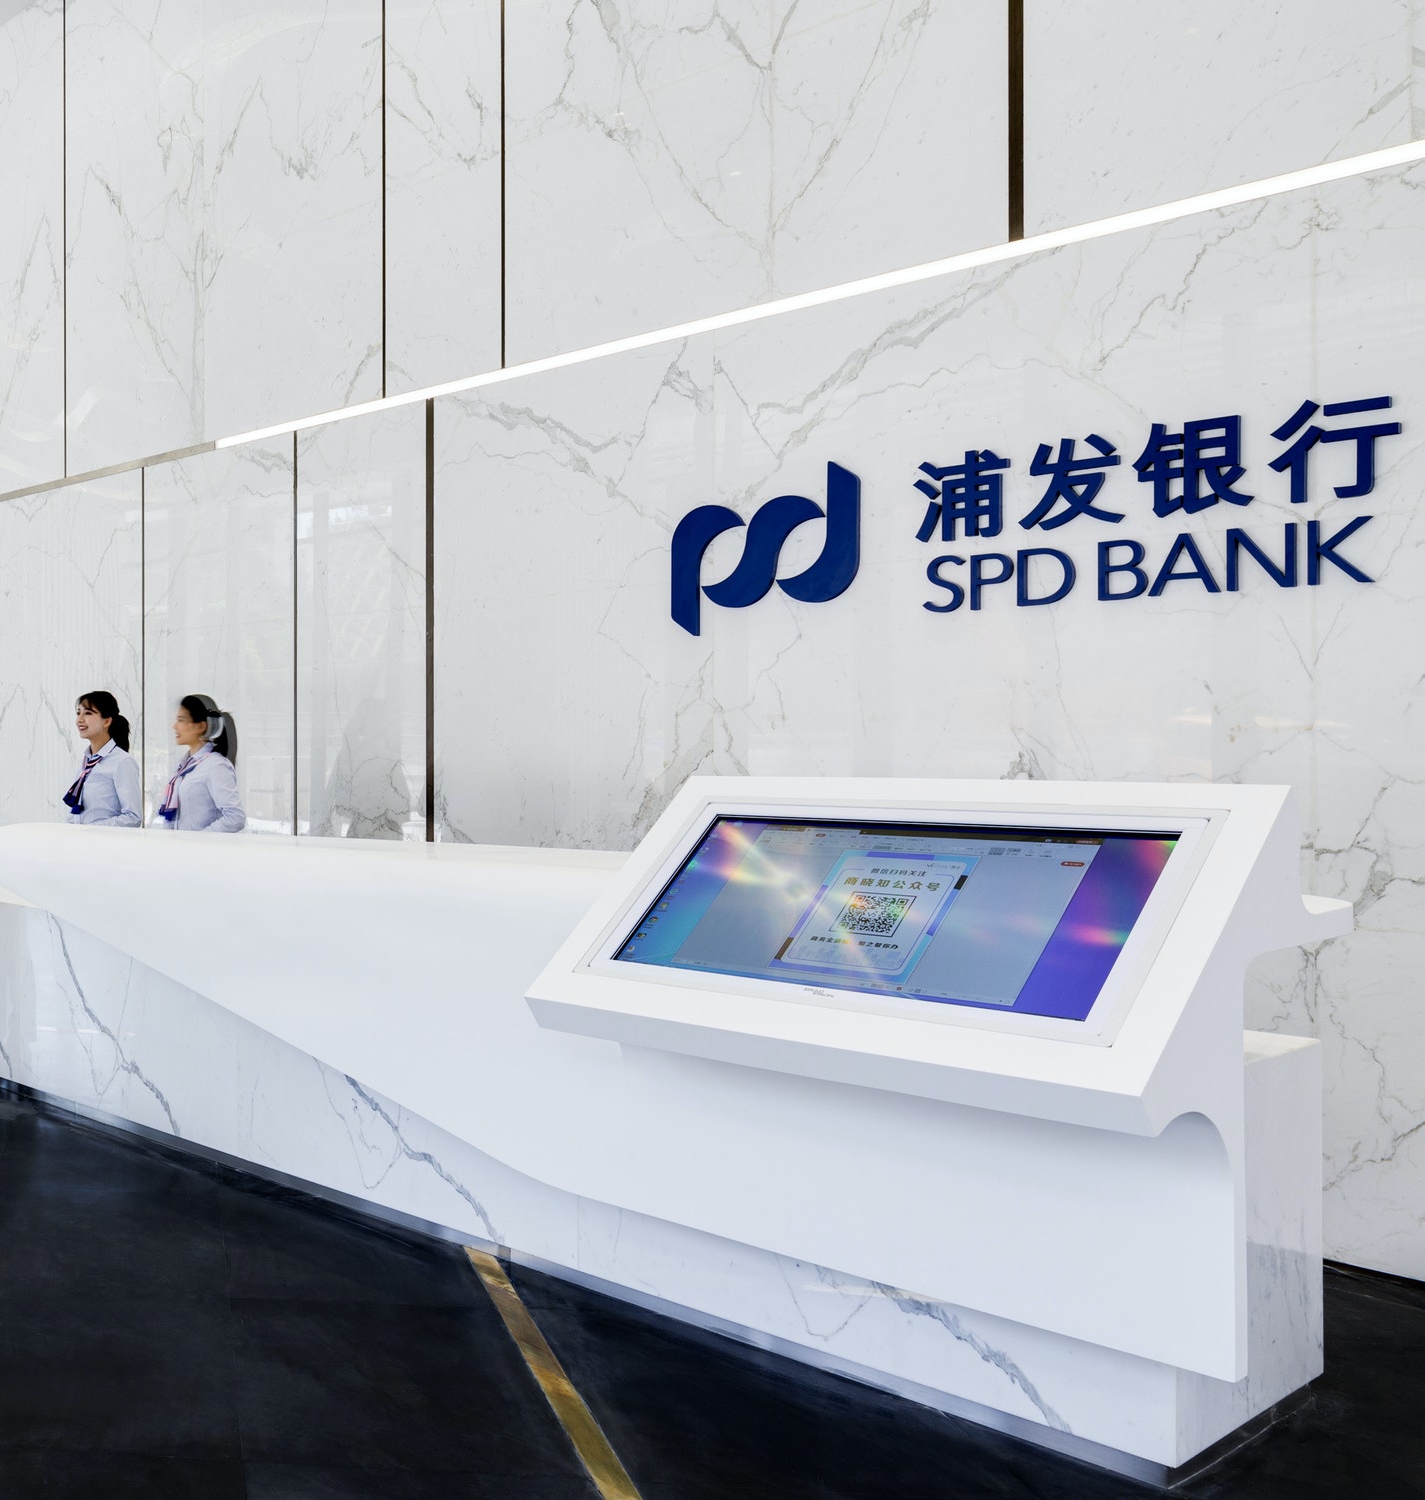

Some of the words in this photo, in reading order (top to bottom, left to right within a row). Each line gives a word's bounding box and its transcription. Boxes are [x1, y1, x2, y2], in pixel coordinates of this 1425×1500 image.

[912, 395, 1403, 544] 浦发银行
[922, 547, 1077, 614] SPD
[1097, 515, 1376, 602] BANK
